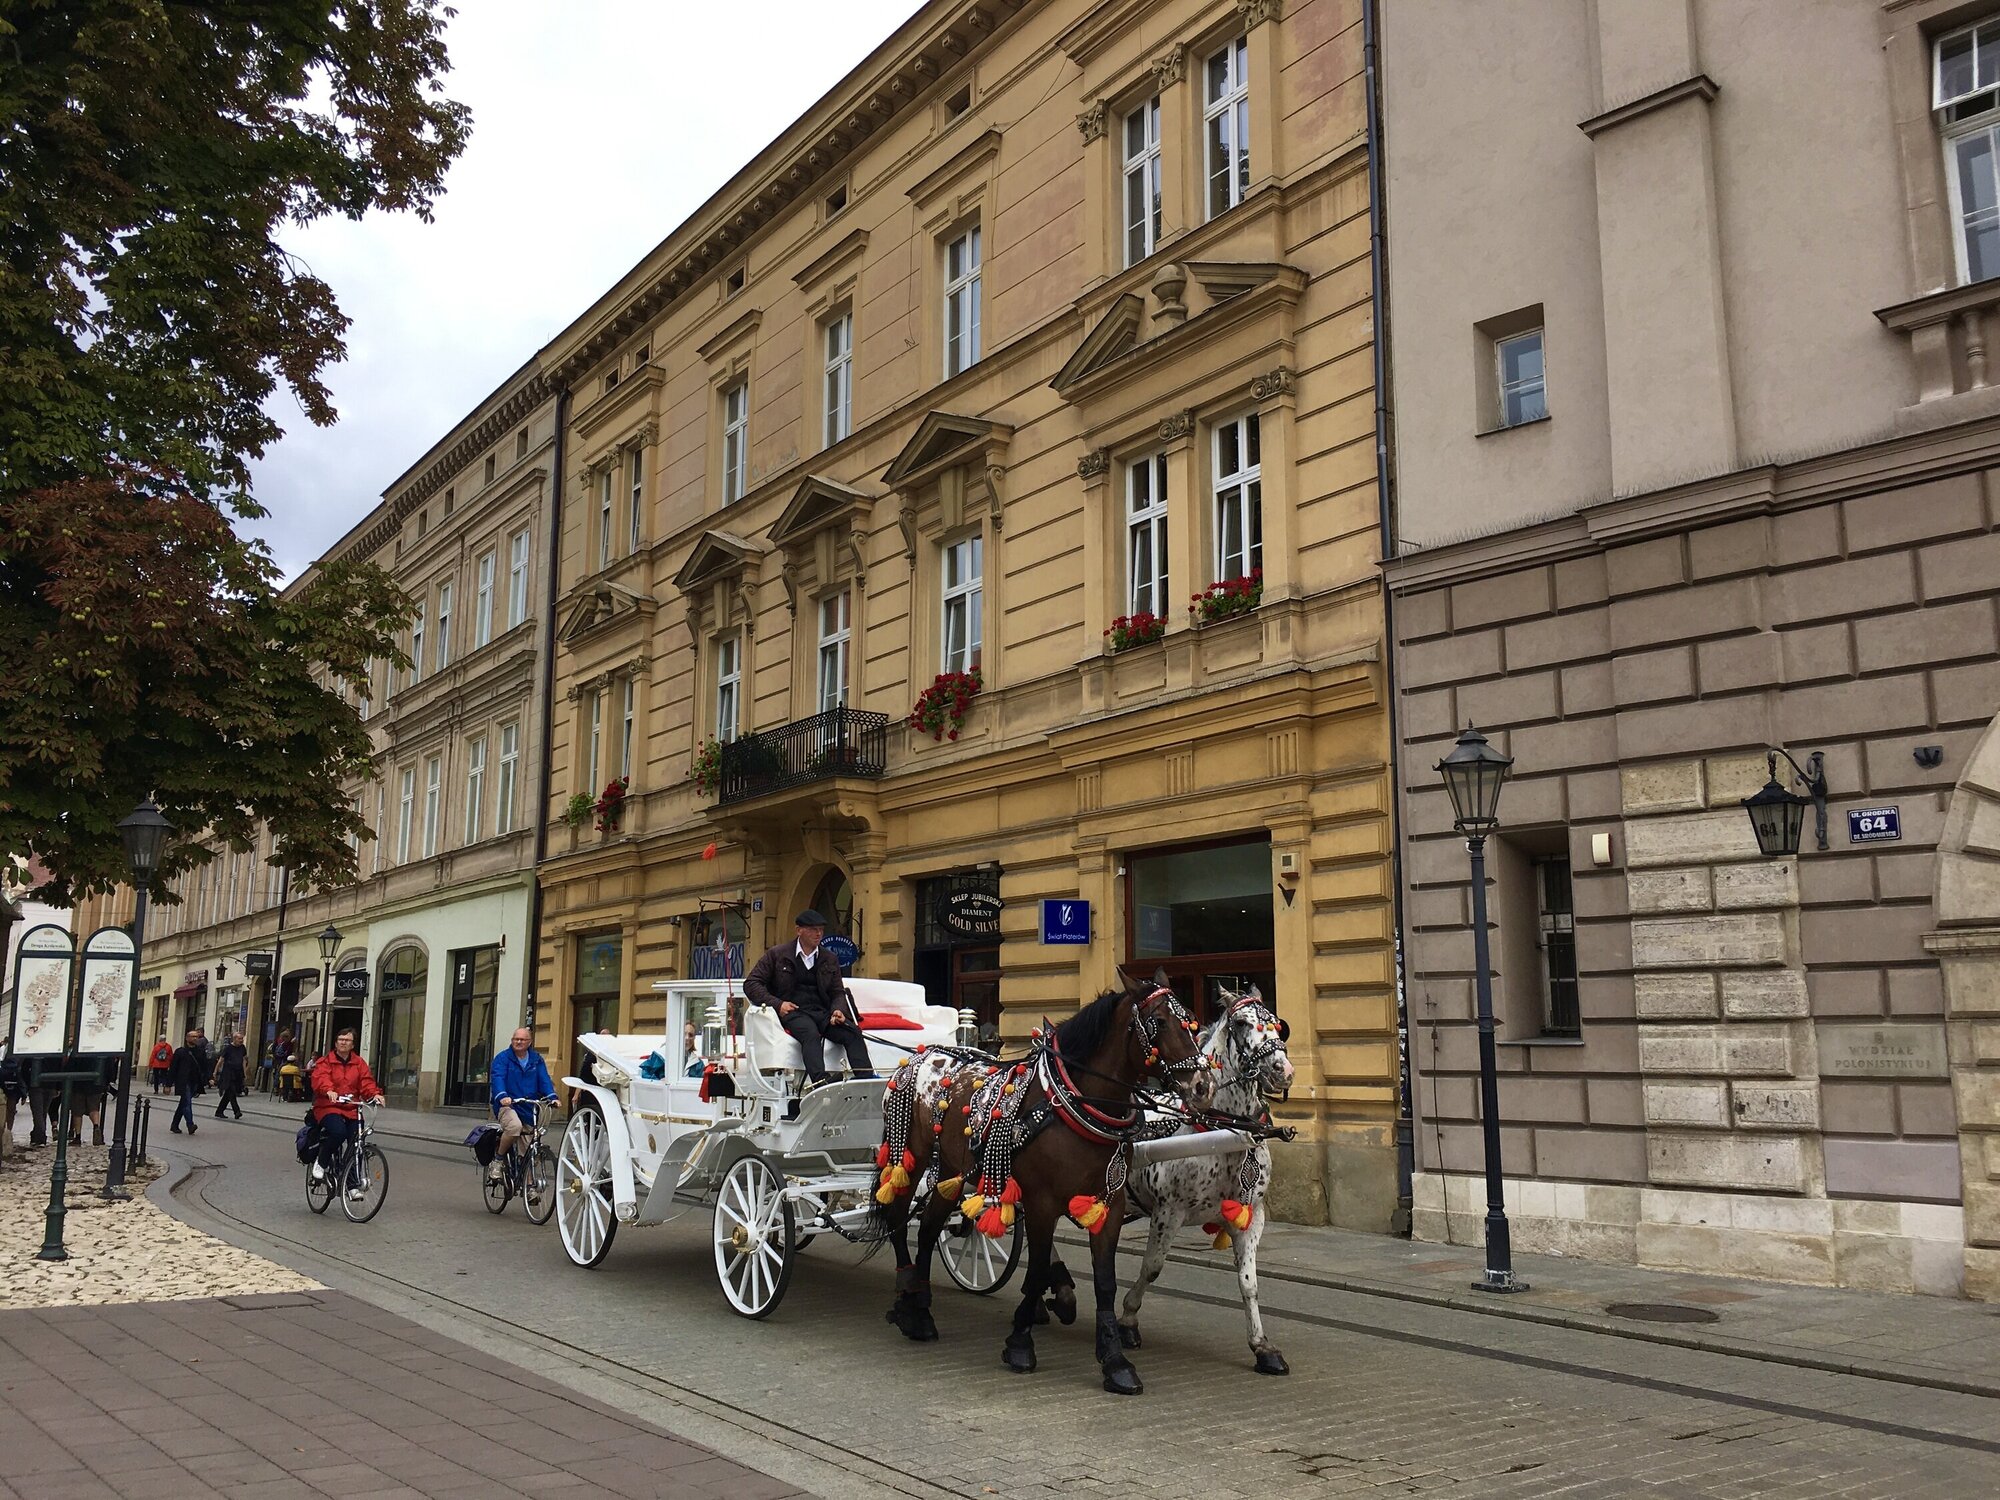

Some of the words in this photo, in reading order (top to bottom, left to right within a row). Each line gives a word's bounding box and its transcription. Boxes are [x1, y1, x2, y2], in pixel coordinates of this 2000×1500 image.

[1860, 816, 1888, 832] 64
[951, 893, 969, 904] SKLEP
[961, 908, 993, 917] DIAMENT
[948, 912, 972, 931] GOLD
[975, 919, 1000, 933] SILVE
[1848, 1046, 1915, 1056] WYDZIAŁ
[1835, 1060, 1913, 1069] POLONISTYKI
